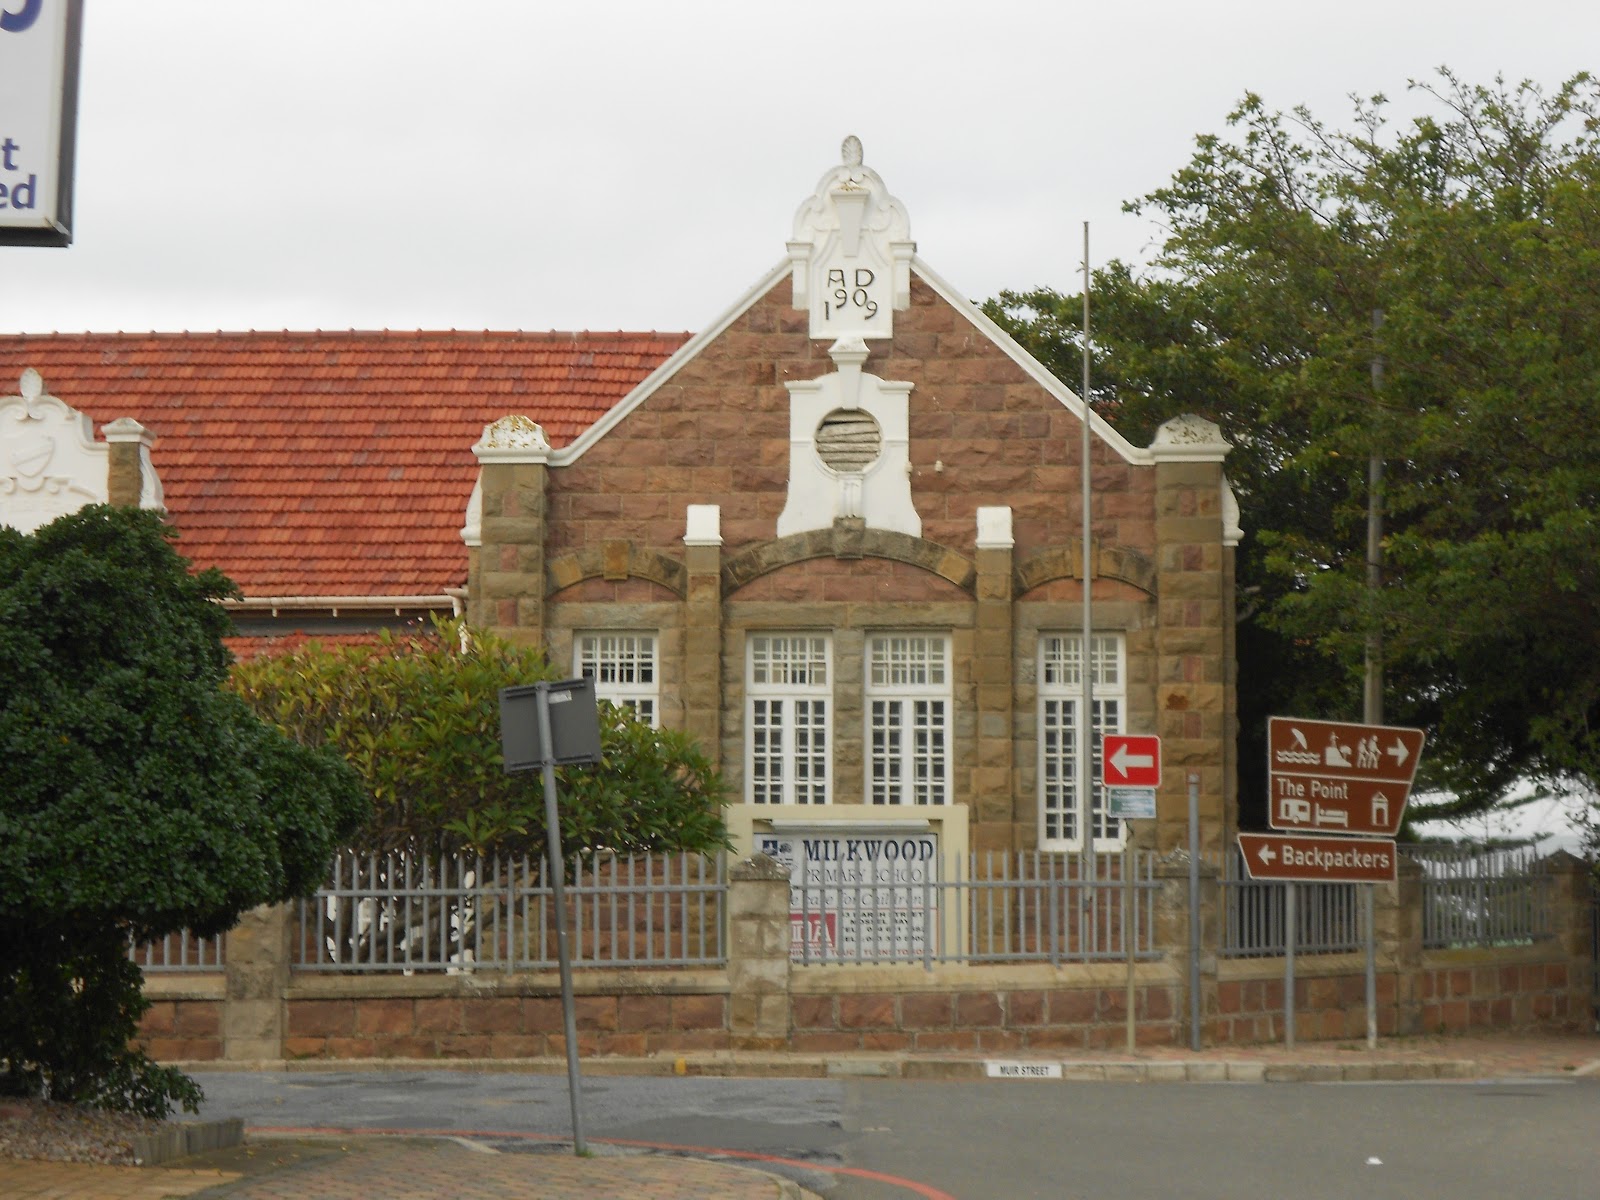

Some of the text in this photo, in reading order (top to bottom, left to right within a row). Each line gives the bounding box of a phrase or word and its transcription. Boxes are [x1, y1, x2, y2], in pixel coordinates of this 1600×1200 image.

[824, 289, 878, 320] 1909
[1277, 777, 1349, 800] The Point
[803, 840, 933, 861] MILKWOOD
[1282, 845, 1390, 871] Backpackers
[803, 869, 927, 882] RMARY COO
[1000, 1065, 1050, 1076] MUIR STREET
